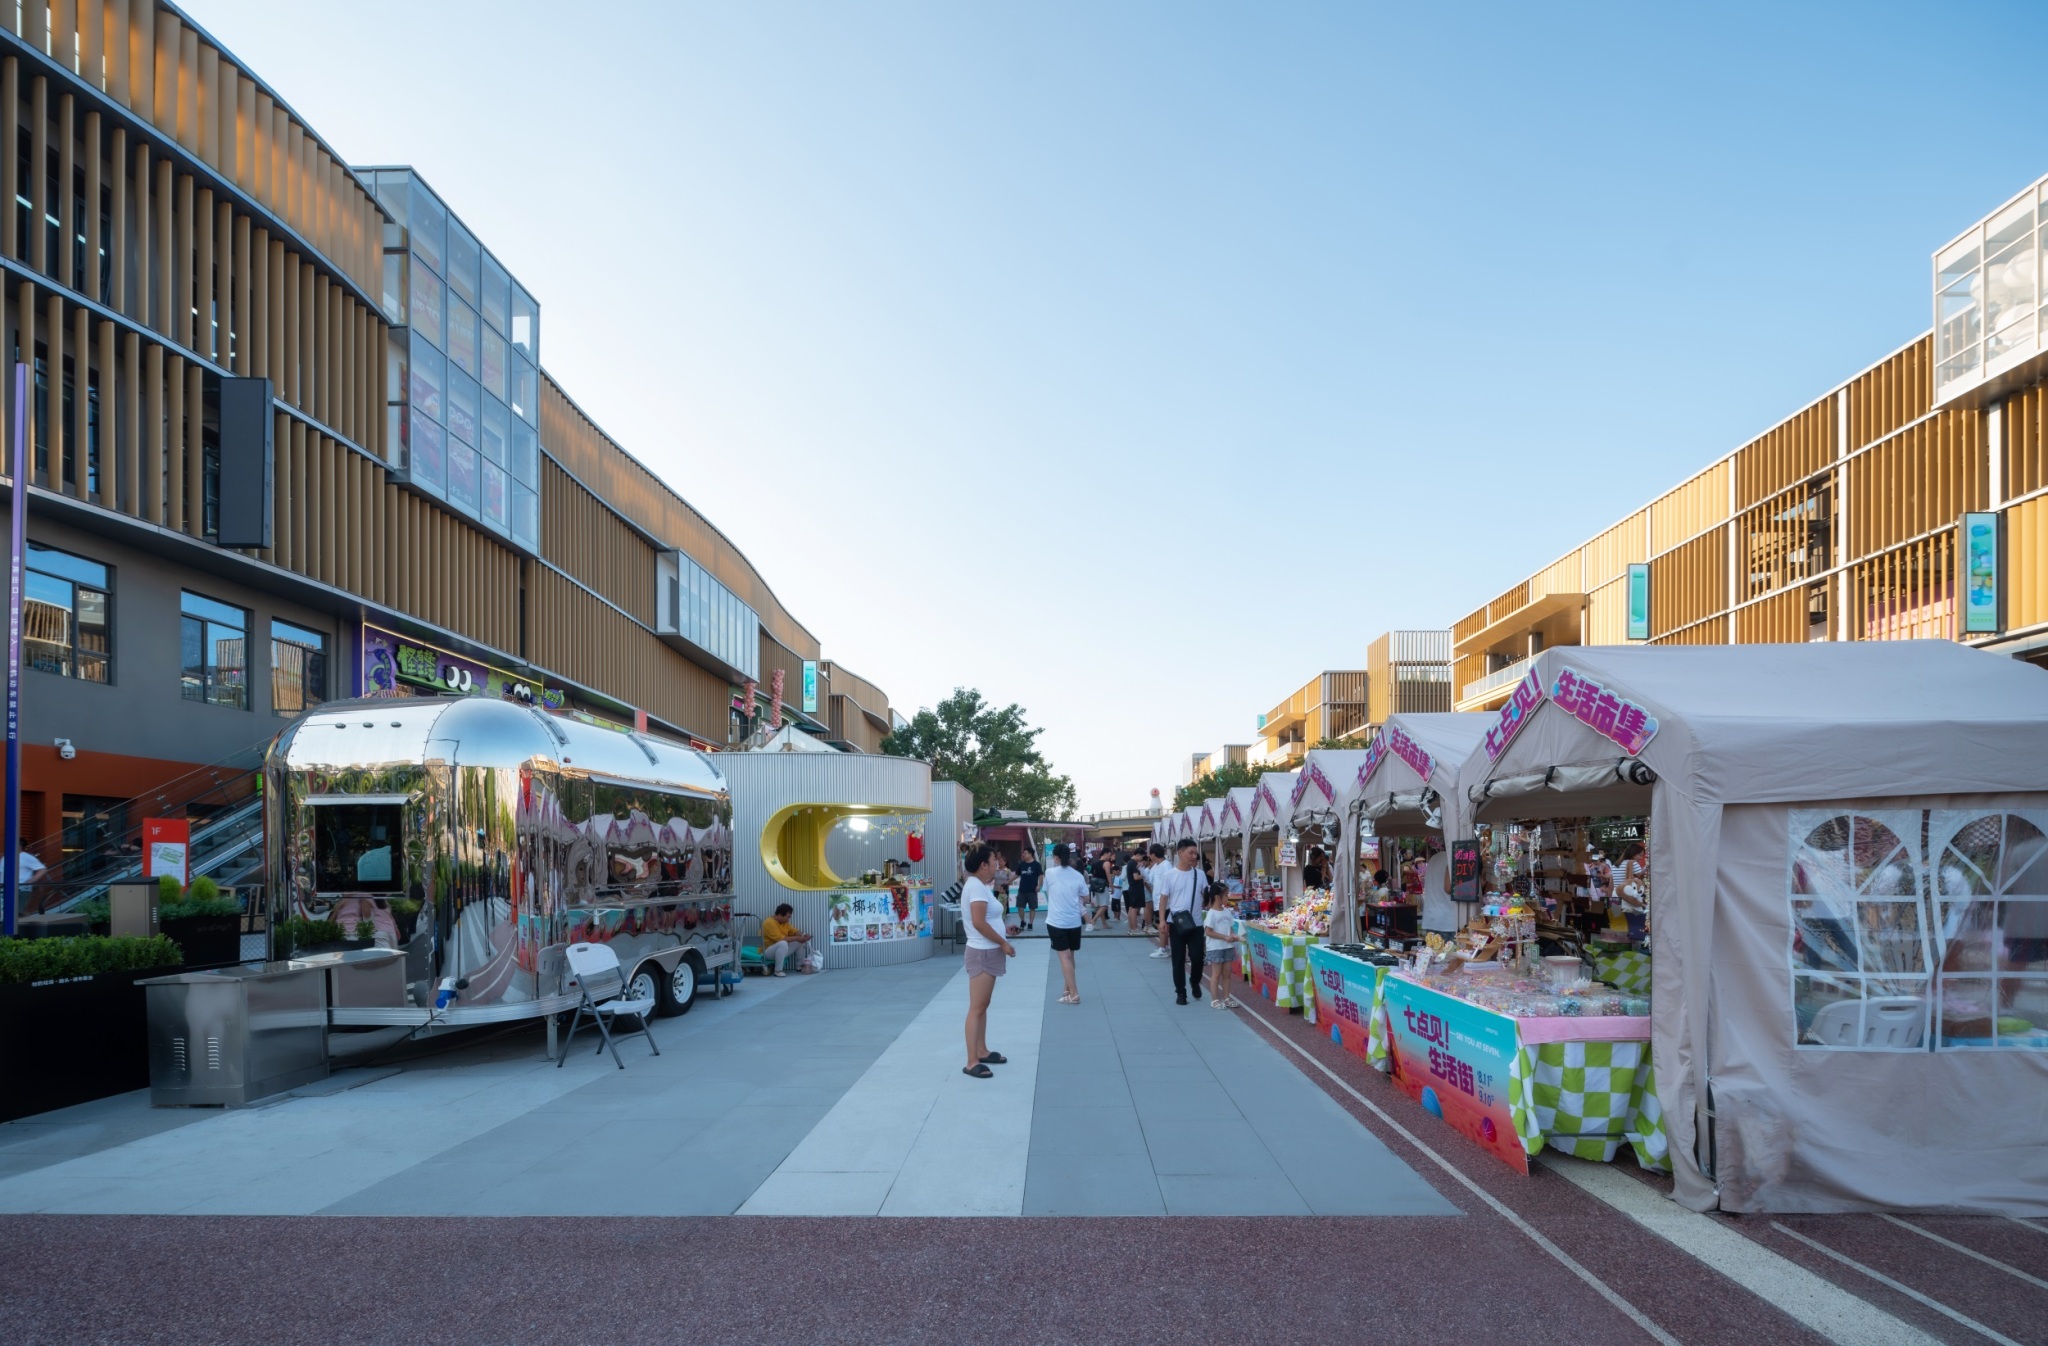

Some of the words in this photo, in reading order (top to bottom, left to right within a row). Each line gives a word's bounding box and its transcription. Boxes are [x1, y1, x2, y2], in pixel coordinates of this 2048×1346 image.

[1554, 669, 1648, 755] 生活市集
[1389, 725, 1432, 782] 生活市集
[152, 826, 162, 835] 1F
[1456, 862, 1475, 876] DIY
[1464, 1035, 1475, 1047] YOU
[1475, 1040, 1482, 1049] AT
[1428, 1046, 1475, 1097] 生活街
